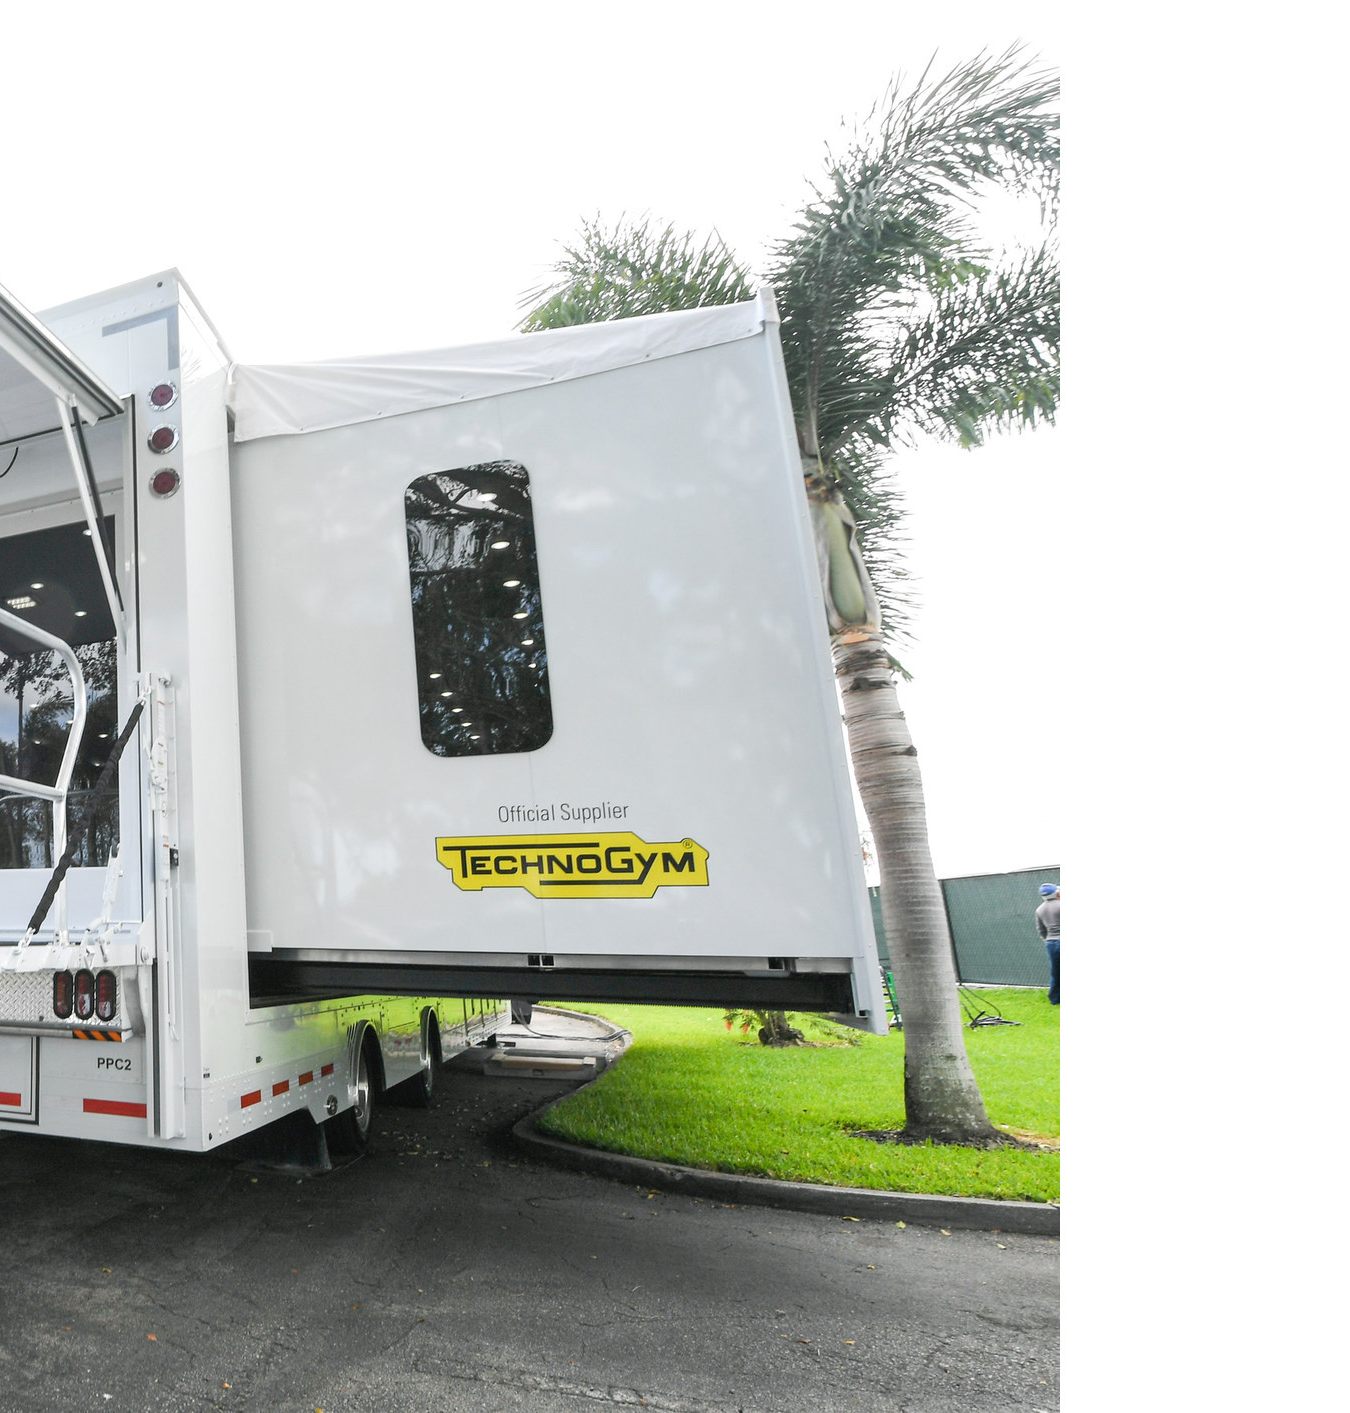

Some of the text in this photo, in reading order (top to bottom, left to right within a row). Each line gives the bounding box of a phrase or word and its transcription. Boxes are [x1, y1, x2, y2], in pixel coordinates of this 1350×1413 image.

[498, 802, 629, 824] Official Supplier
[97, 1057, 132, 1071] PPC2
